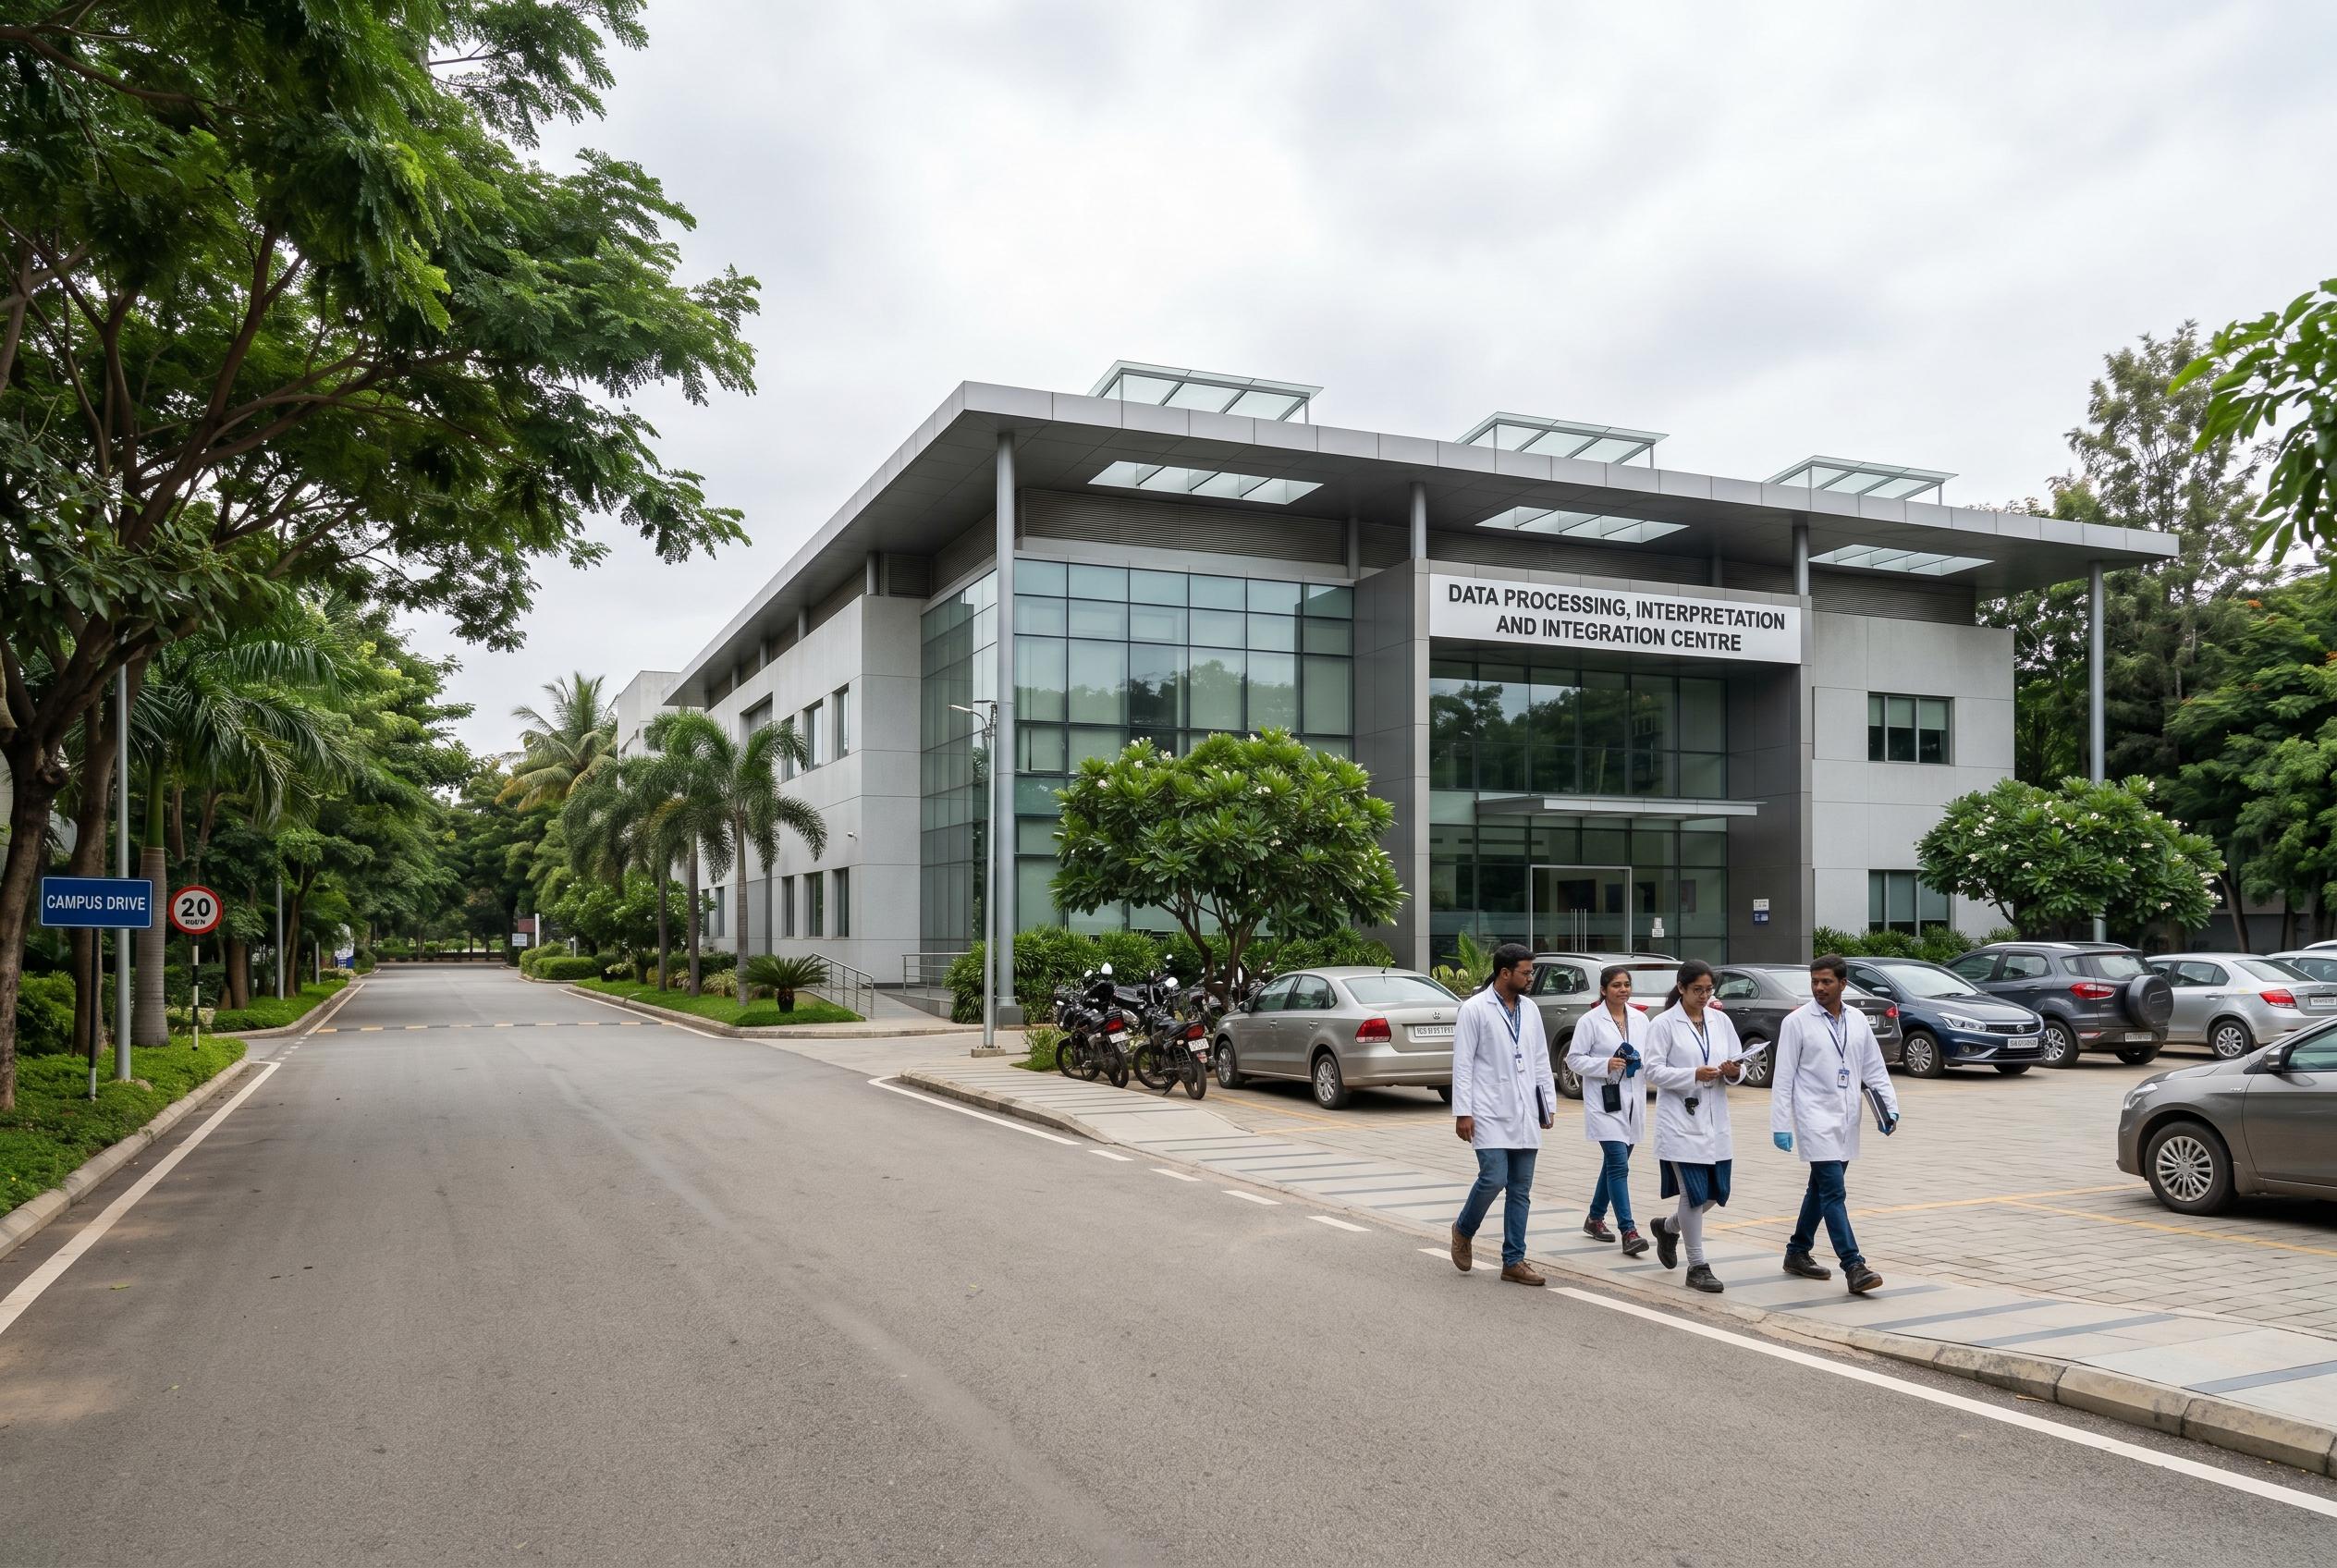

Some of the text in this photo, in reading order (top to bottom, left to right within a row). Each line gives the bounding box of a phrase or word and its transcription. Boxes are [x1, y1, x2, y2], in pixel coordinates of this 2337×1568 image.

[1449, 583, 1785, 631] DATA PROCESSING, INTERPRETATION
[1496, 615, 1742, 652] AND INTEGRATION CENTRE
[46, 894, 146, 911] CAMPUS DRIVE
[181, 897, 211, 917] 20
